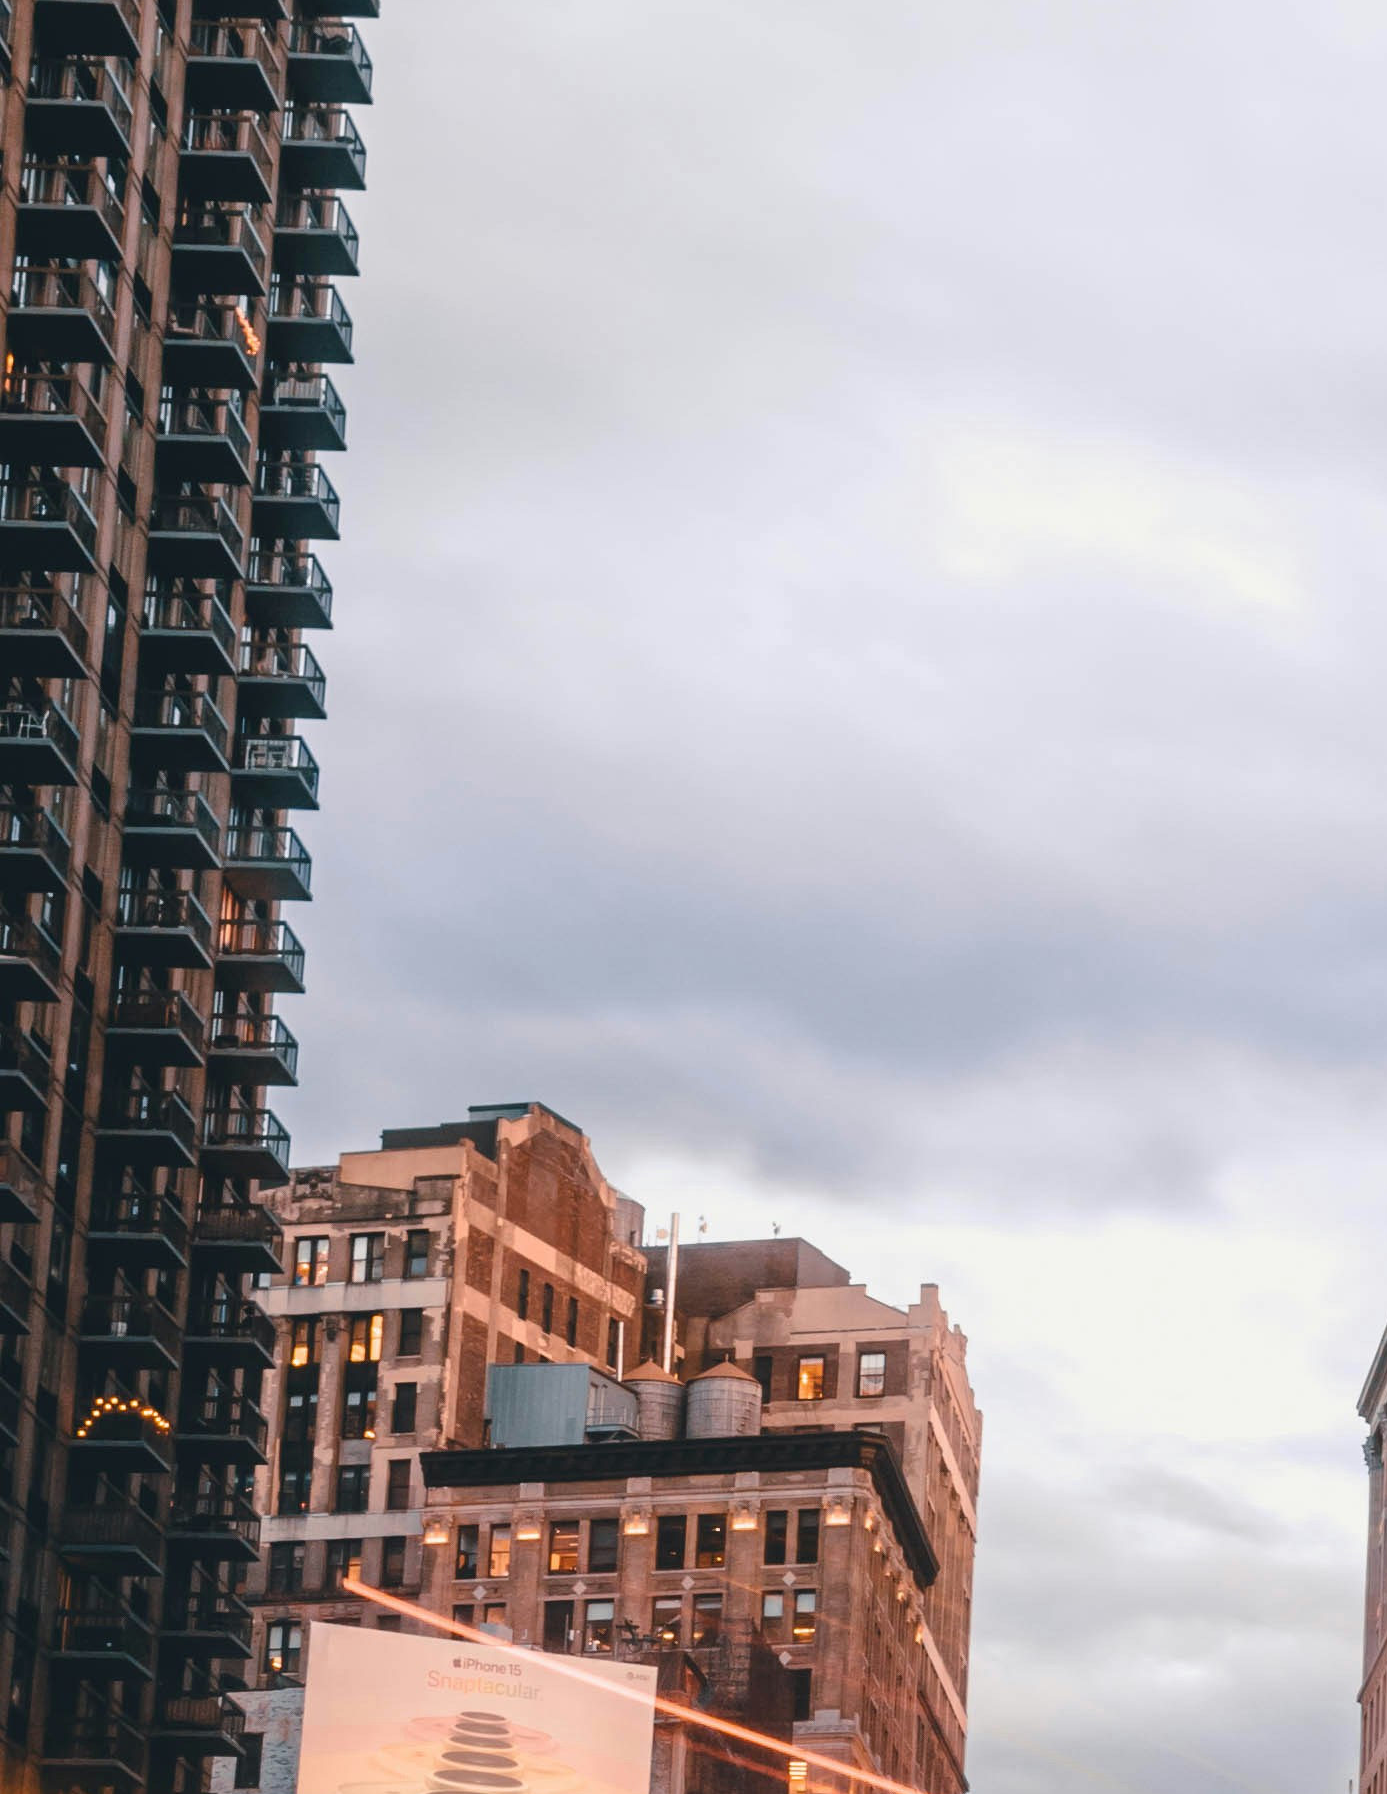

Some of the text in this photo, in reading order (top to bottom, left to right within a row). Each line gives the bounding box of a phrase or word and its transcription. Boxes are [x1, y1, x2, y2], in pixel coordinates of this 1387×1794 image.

[463, 1657, 522, 1676] iPhone 15
[427, 1669, 544, 1701] Snaptacular.
